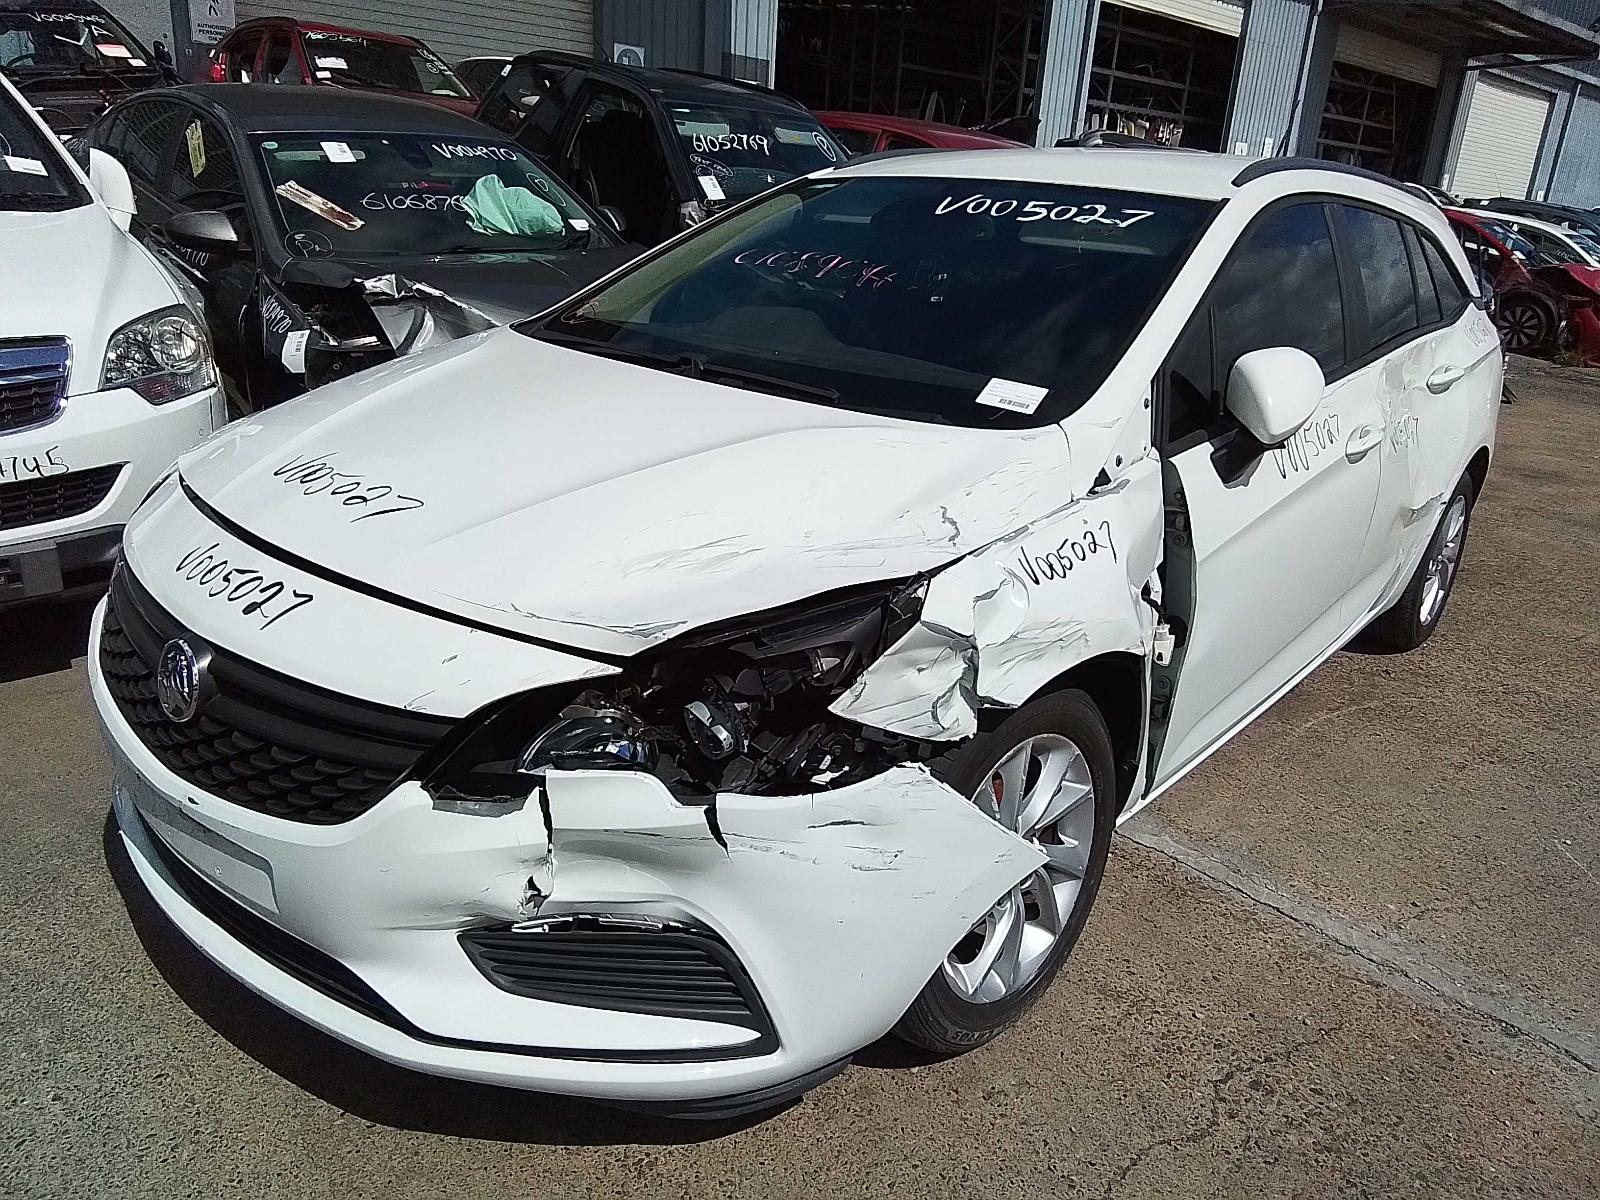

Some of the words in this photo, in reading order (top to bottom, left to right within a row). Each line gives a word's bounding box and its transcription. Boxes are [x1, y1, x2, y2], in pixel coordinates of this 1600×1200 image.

[431, 142, 517, 161] V004970
[693, 132, 770, 156] 61052769
[360, 192, 467, 212] 6106876
[934, 194, 1155, 228] V005027
[273, 451, 425, 524] V005027
[1017, 520, 1117, 586] V005027
[175, 542, 315, 632] V005027
